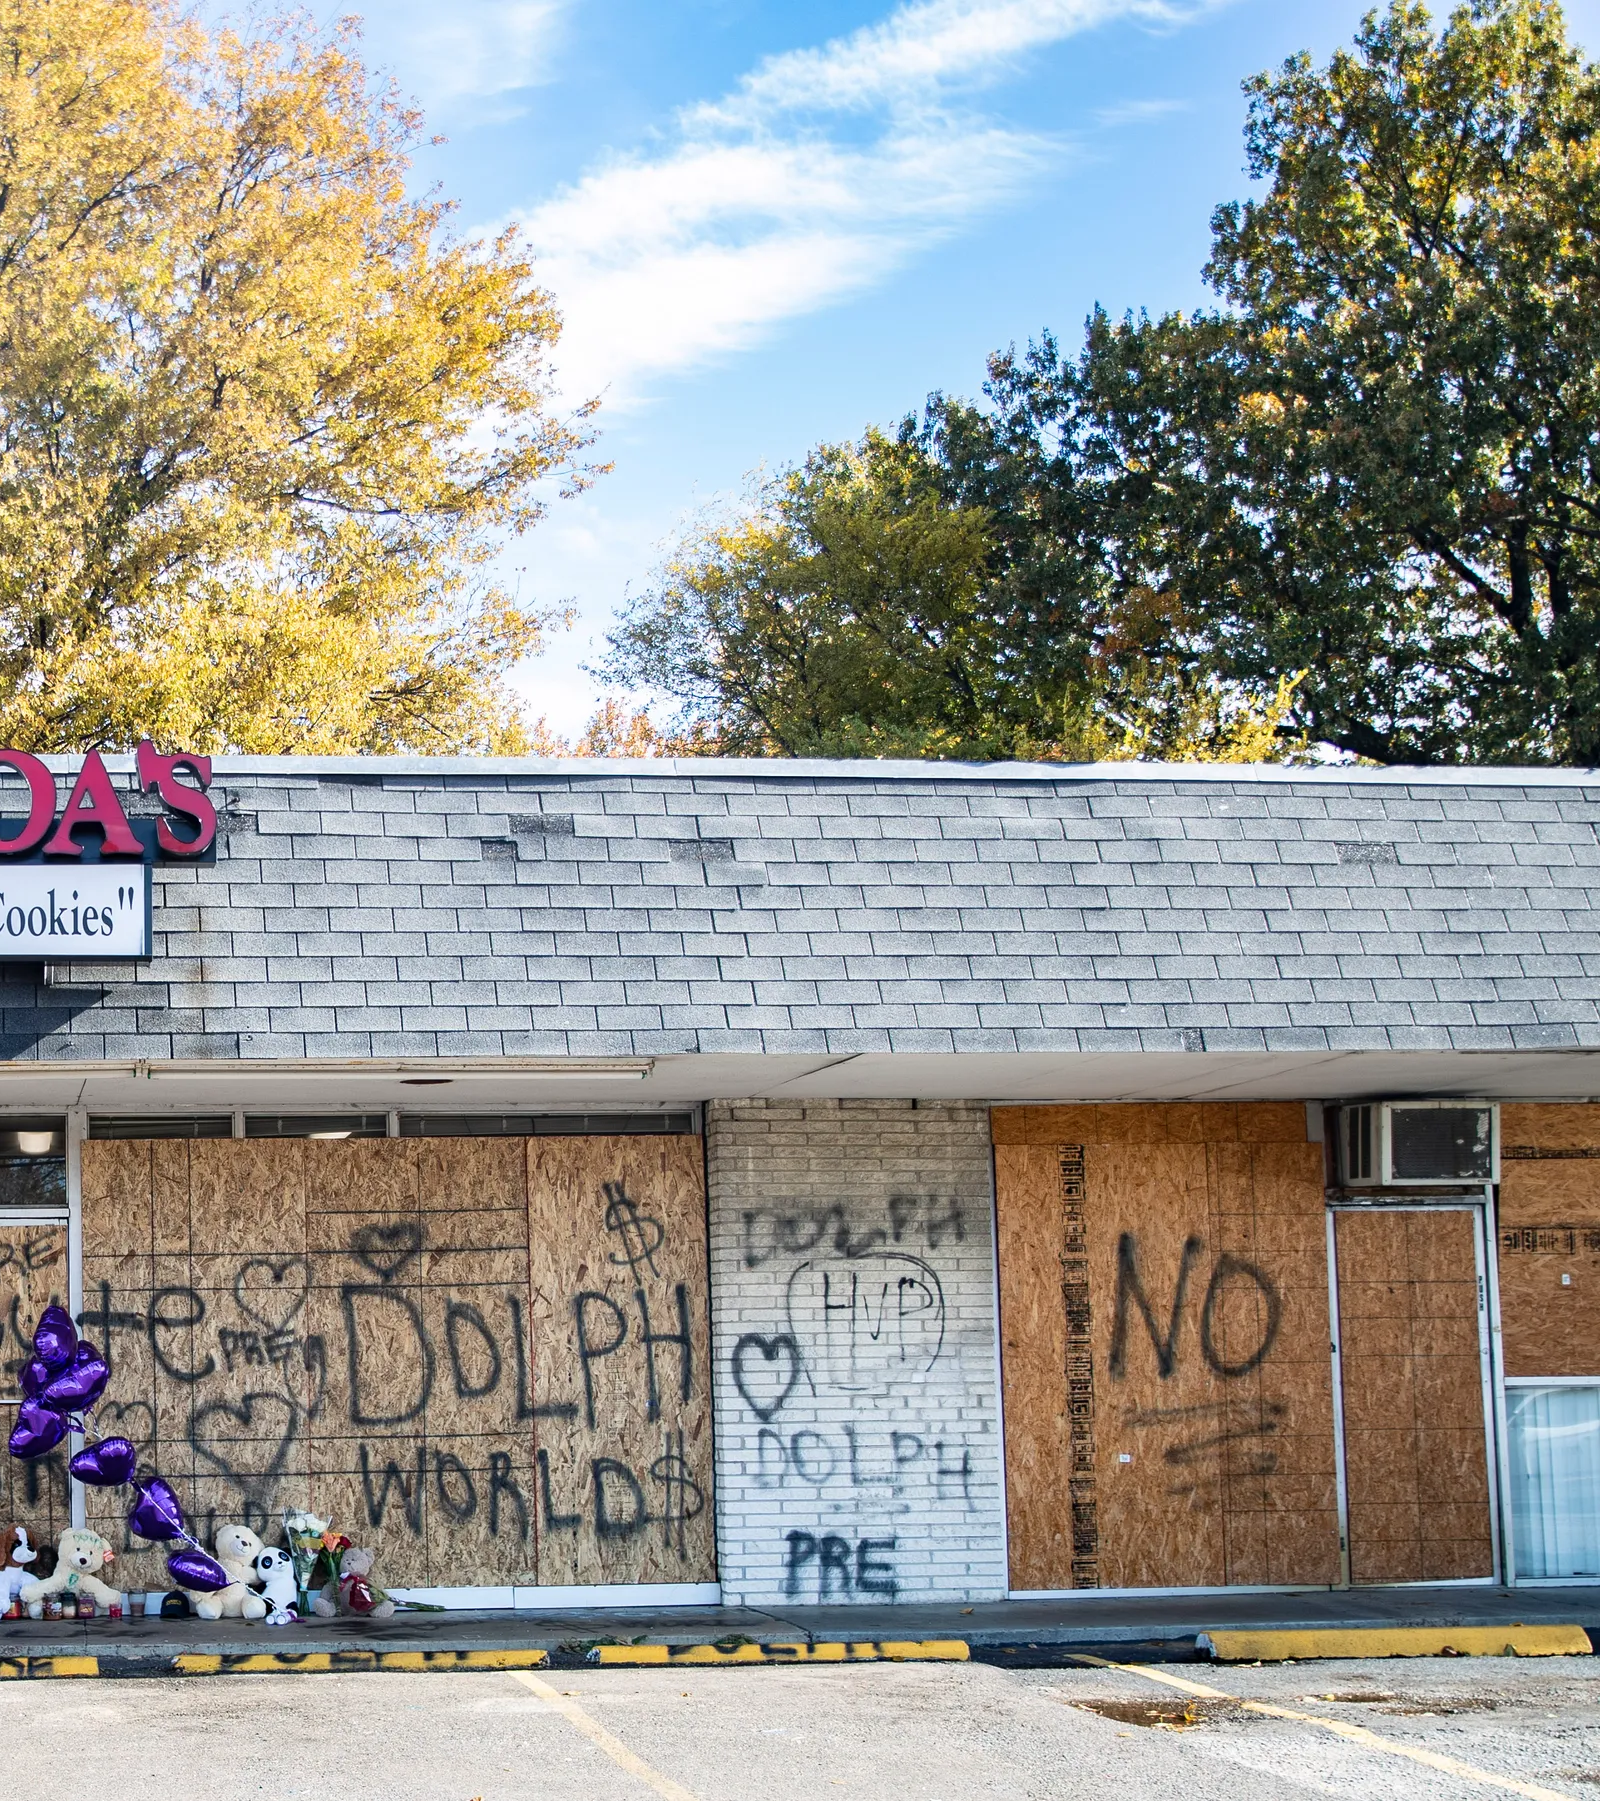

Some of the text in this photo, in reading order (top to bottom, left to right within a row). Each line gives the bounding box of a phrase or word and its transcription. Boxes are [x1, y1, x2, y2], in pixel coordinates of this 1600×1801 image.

[1108, 1232, 1283, 1380] NO
[220, 1326, 294, 1373] PRE
[342, 1283, 692, 1431] DOLPH
[757, 1426, 977, 1511] DOLPH
[786, 1530, 898, 1595] PRE
